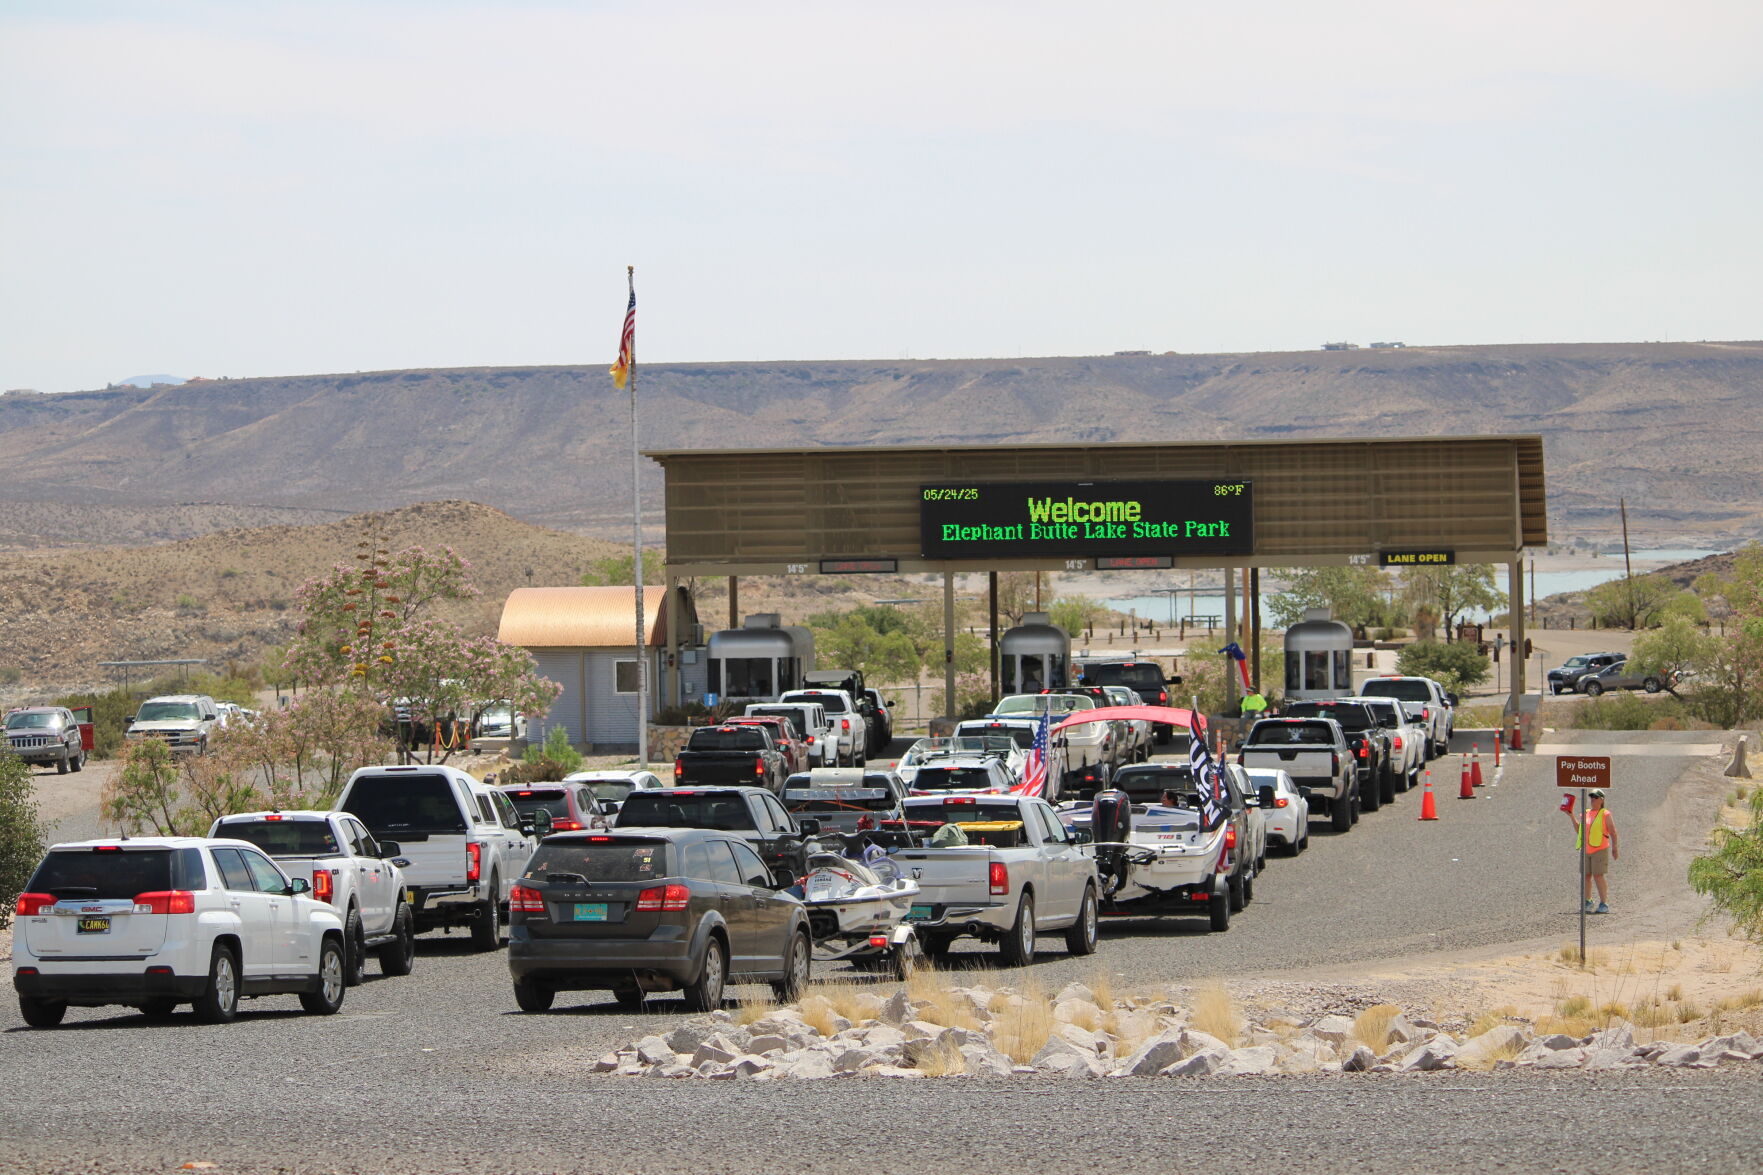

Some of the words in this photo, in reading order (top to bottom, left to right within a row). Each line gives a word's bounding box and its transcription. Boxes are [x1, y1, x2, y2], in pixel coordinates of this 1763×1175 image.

[923, 488, 978, 500] 05/24/25
[1027, 497, 1142, 523] Welcome
[942, 523, 1024, 541] Elephant
[1029, 522, 1078, 540] Butte
[1084, 522, 1127, 539] Lake
[1132, 521, 1179, 538] State
[1184, 520, 1230, 538] Park
[1387, 554, 1416, 563] LANE
[1418, 553, 1447, 562] OPEN
[1561, 760, 1576, 771] Pay
[1577, 761, 1606, 770] Booths
[1570, 774, 1597, 783] Ahead
